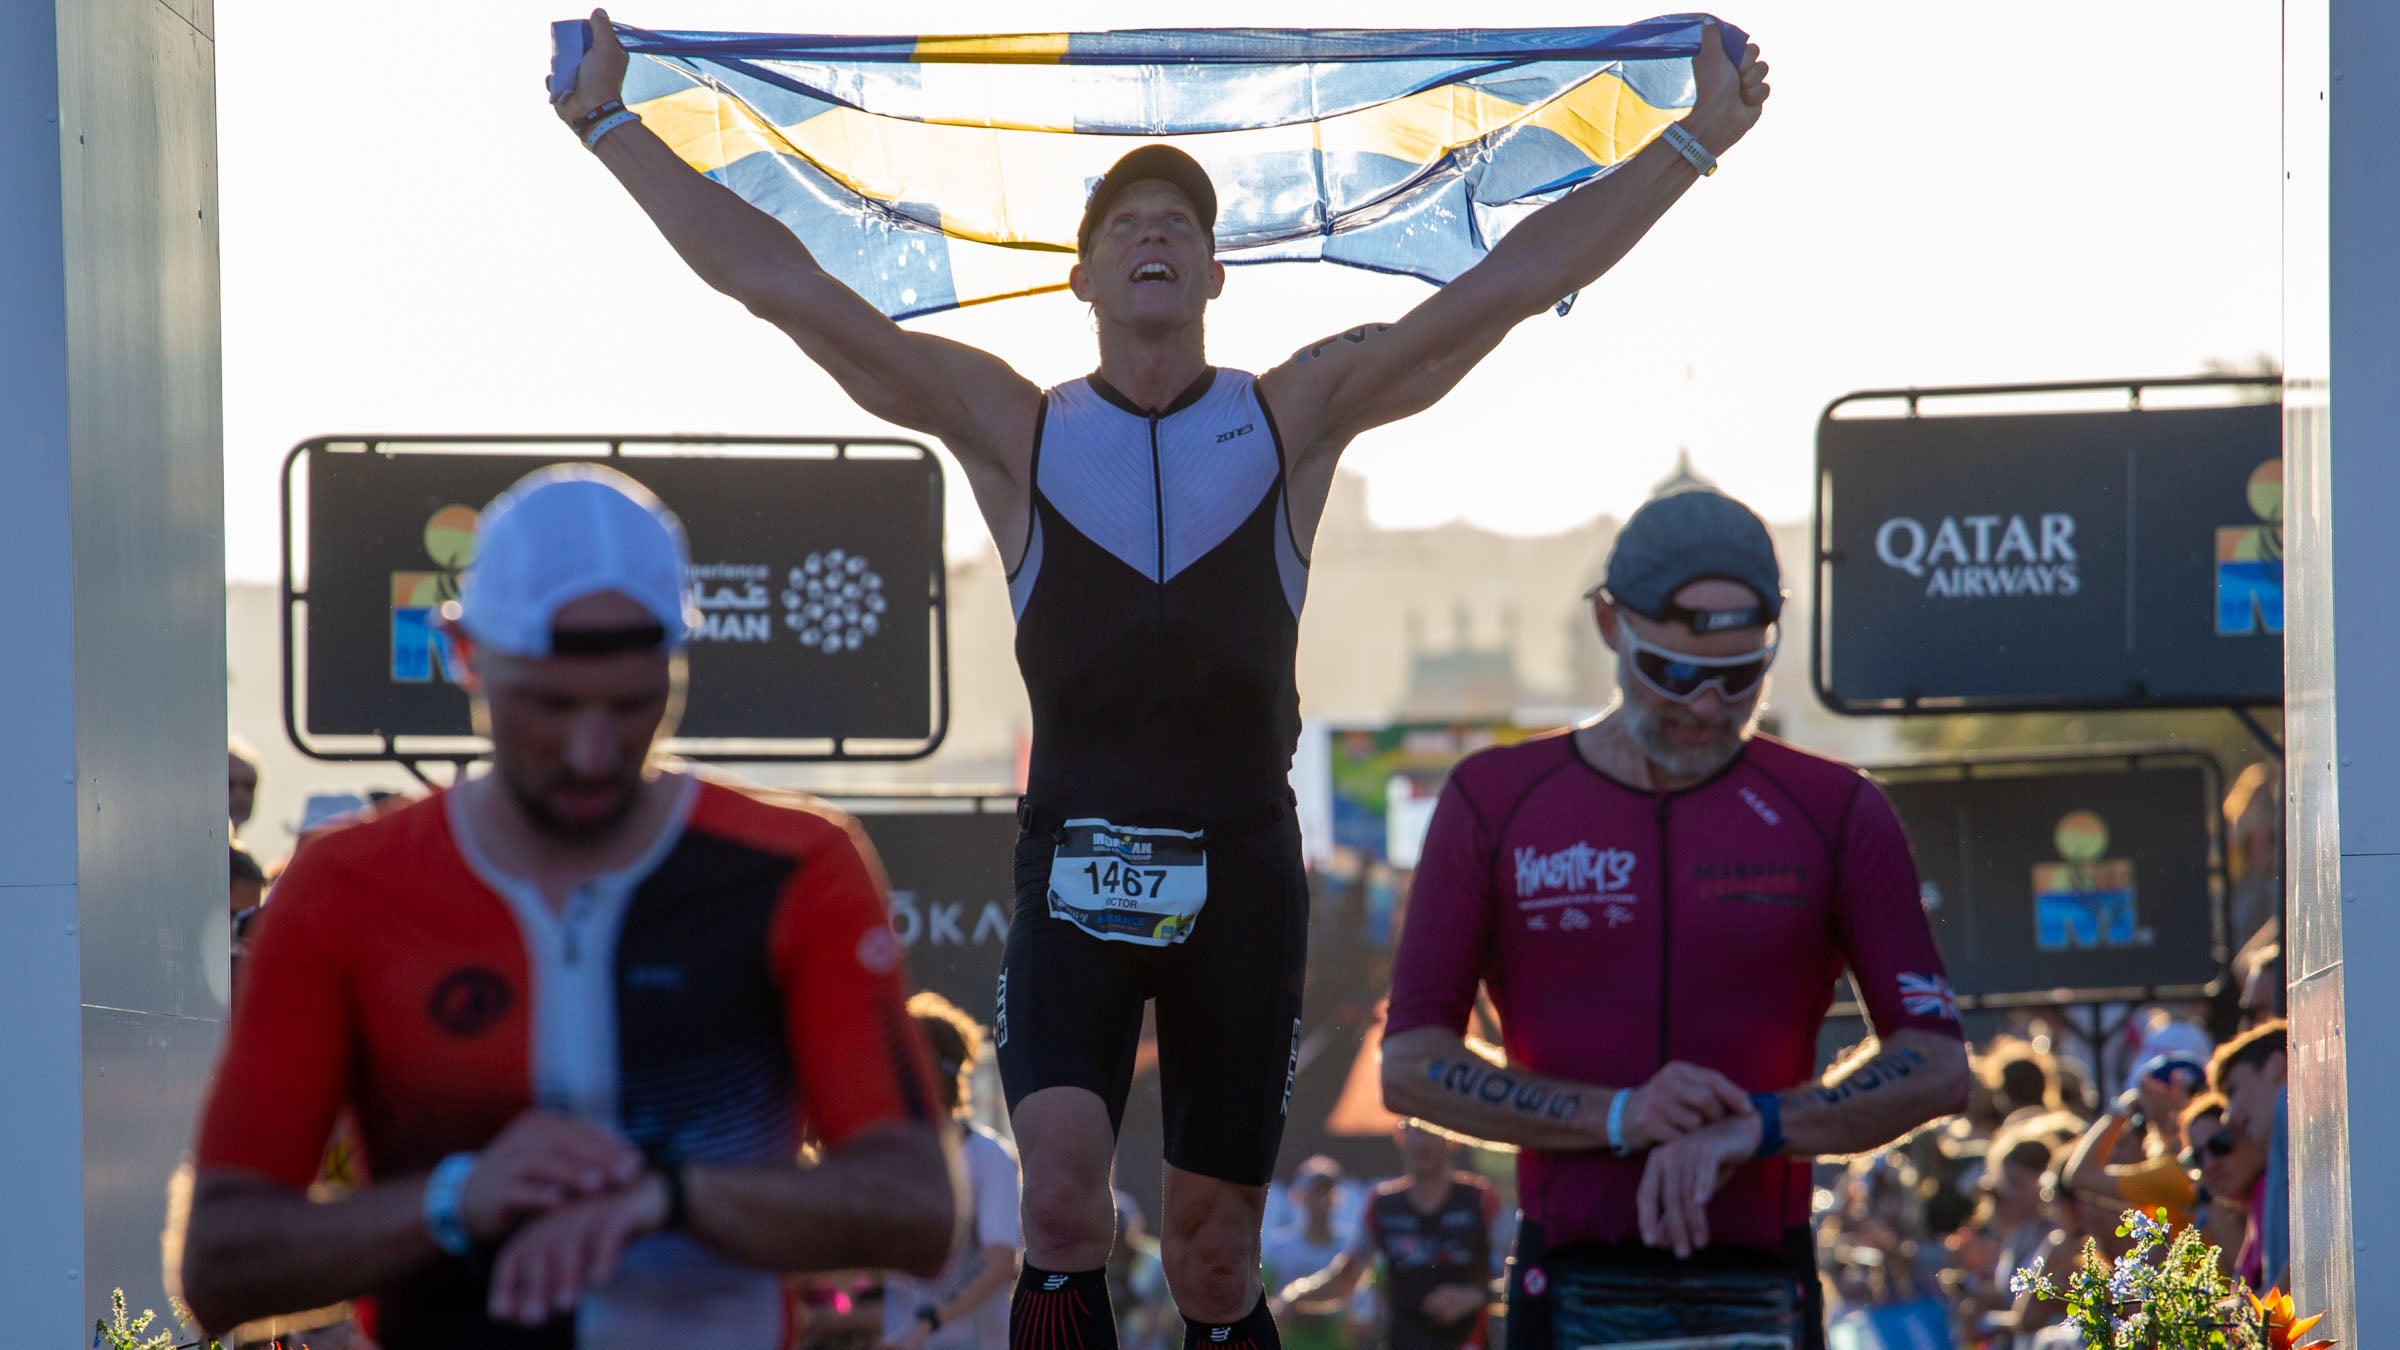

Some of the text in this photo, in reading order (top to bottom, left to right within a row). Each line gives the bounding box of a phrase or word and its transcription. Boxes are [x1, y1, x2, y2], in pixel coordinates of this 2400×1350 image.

[1875, 513, 2079, 575] QATAR
[1925, 563, 2080, 599] AIRWAYS
[1083, 860, 1168, 899] 1467
